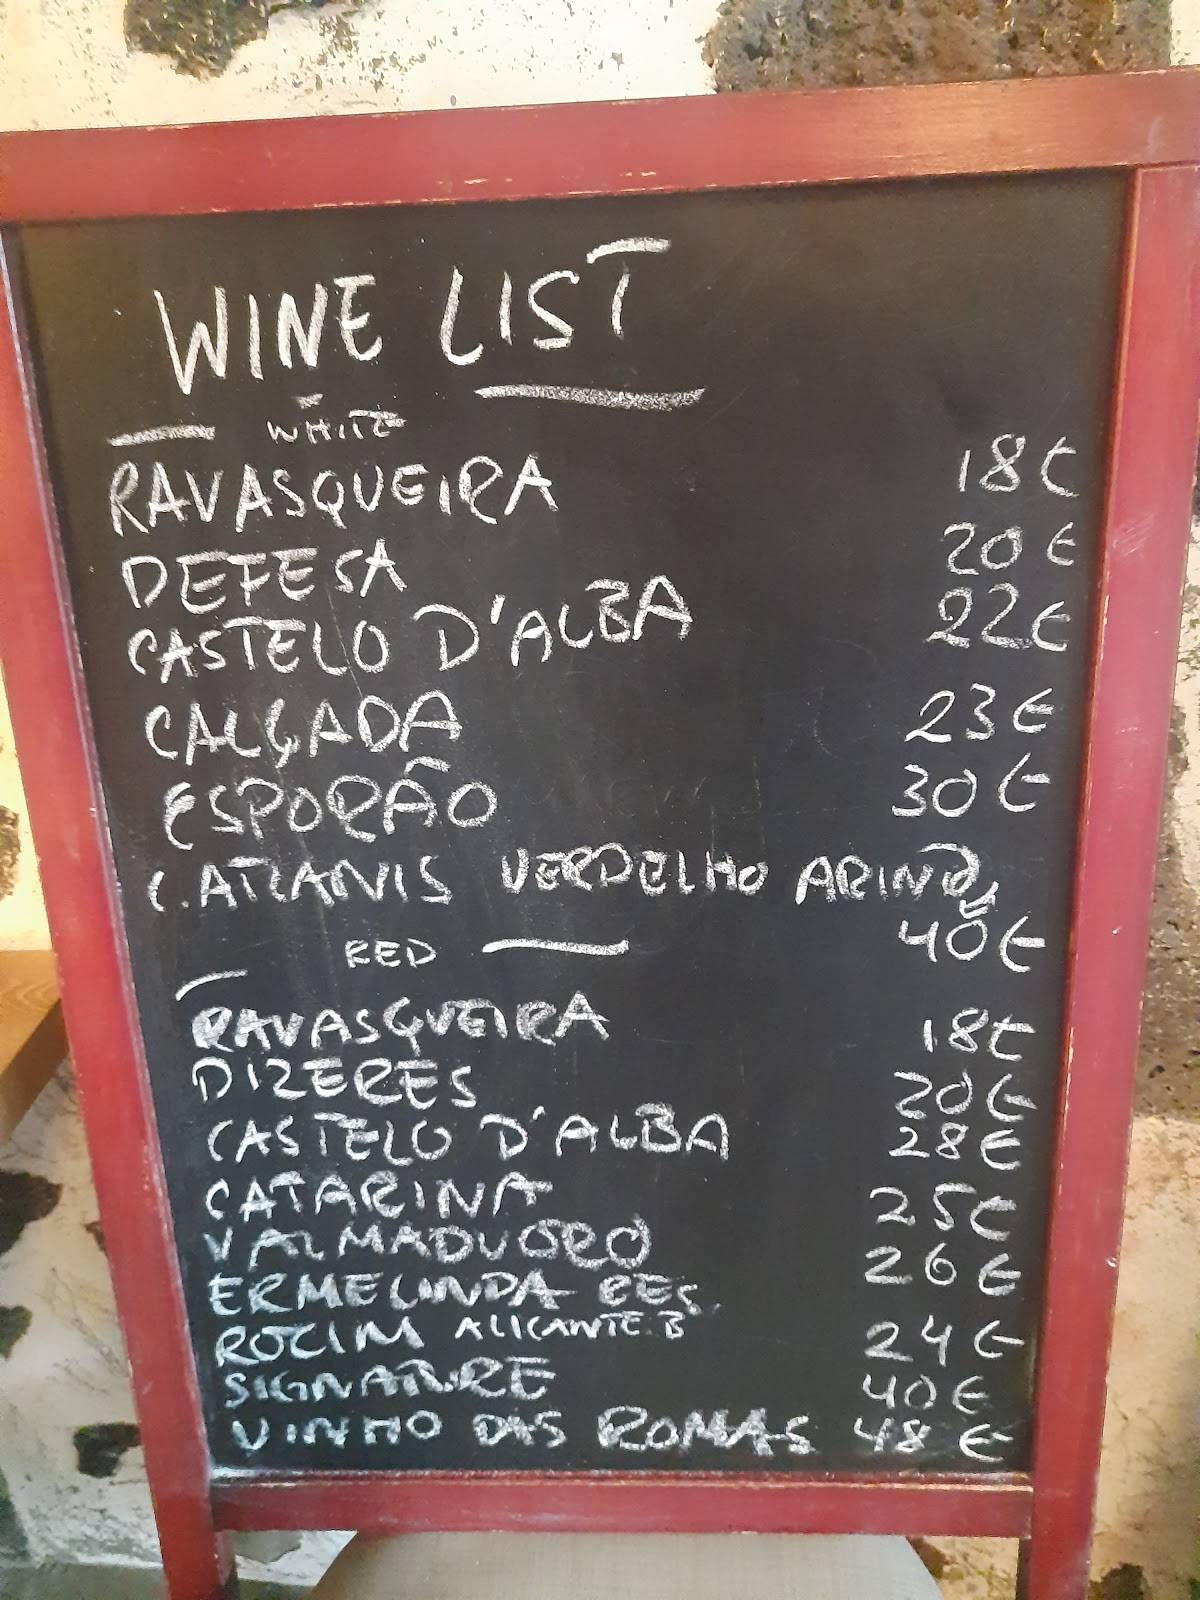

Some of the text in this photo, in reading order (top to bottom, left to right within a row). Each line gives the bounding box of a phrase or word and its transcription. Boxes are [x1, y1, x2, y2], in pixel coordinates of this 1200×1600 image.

[153, 236, 671, 395] WINE LIST
[108, 453, 559, 537] RAVASQUEIRA
[121, 536, 408, 615] DEFESA
[127, 615, 391, 685] CASTELO
[163, 755, 498, 851] ESPORÃO
[344, 937, 438, 969] RED
[191, 990, 610, 1057] RAVASQUEIRA
[191, 1056, 477, 1111] DIZERES
[207, 1111, 453, 1167] CASTELO
[479, 1102, 730, 1161] D'ALBA
[205, 1169, 557, 1225] CATARINA
[232, 1409, 443, 1451] VINHO
[472, 1410, 567, 1448] DAS
